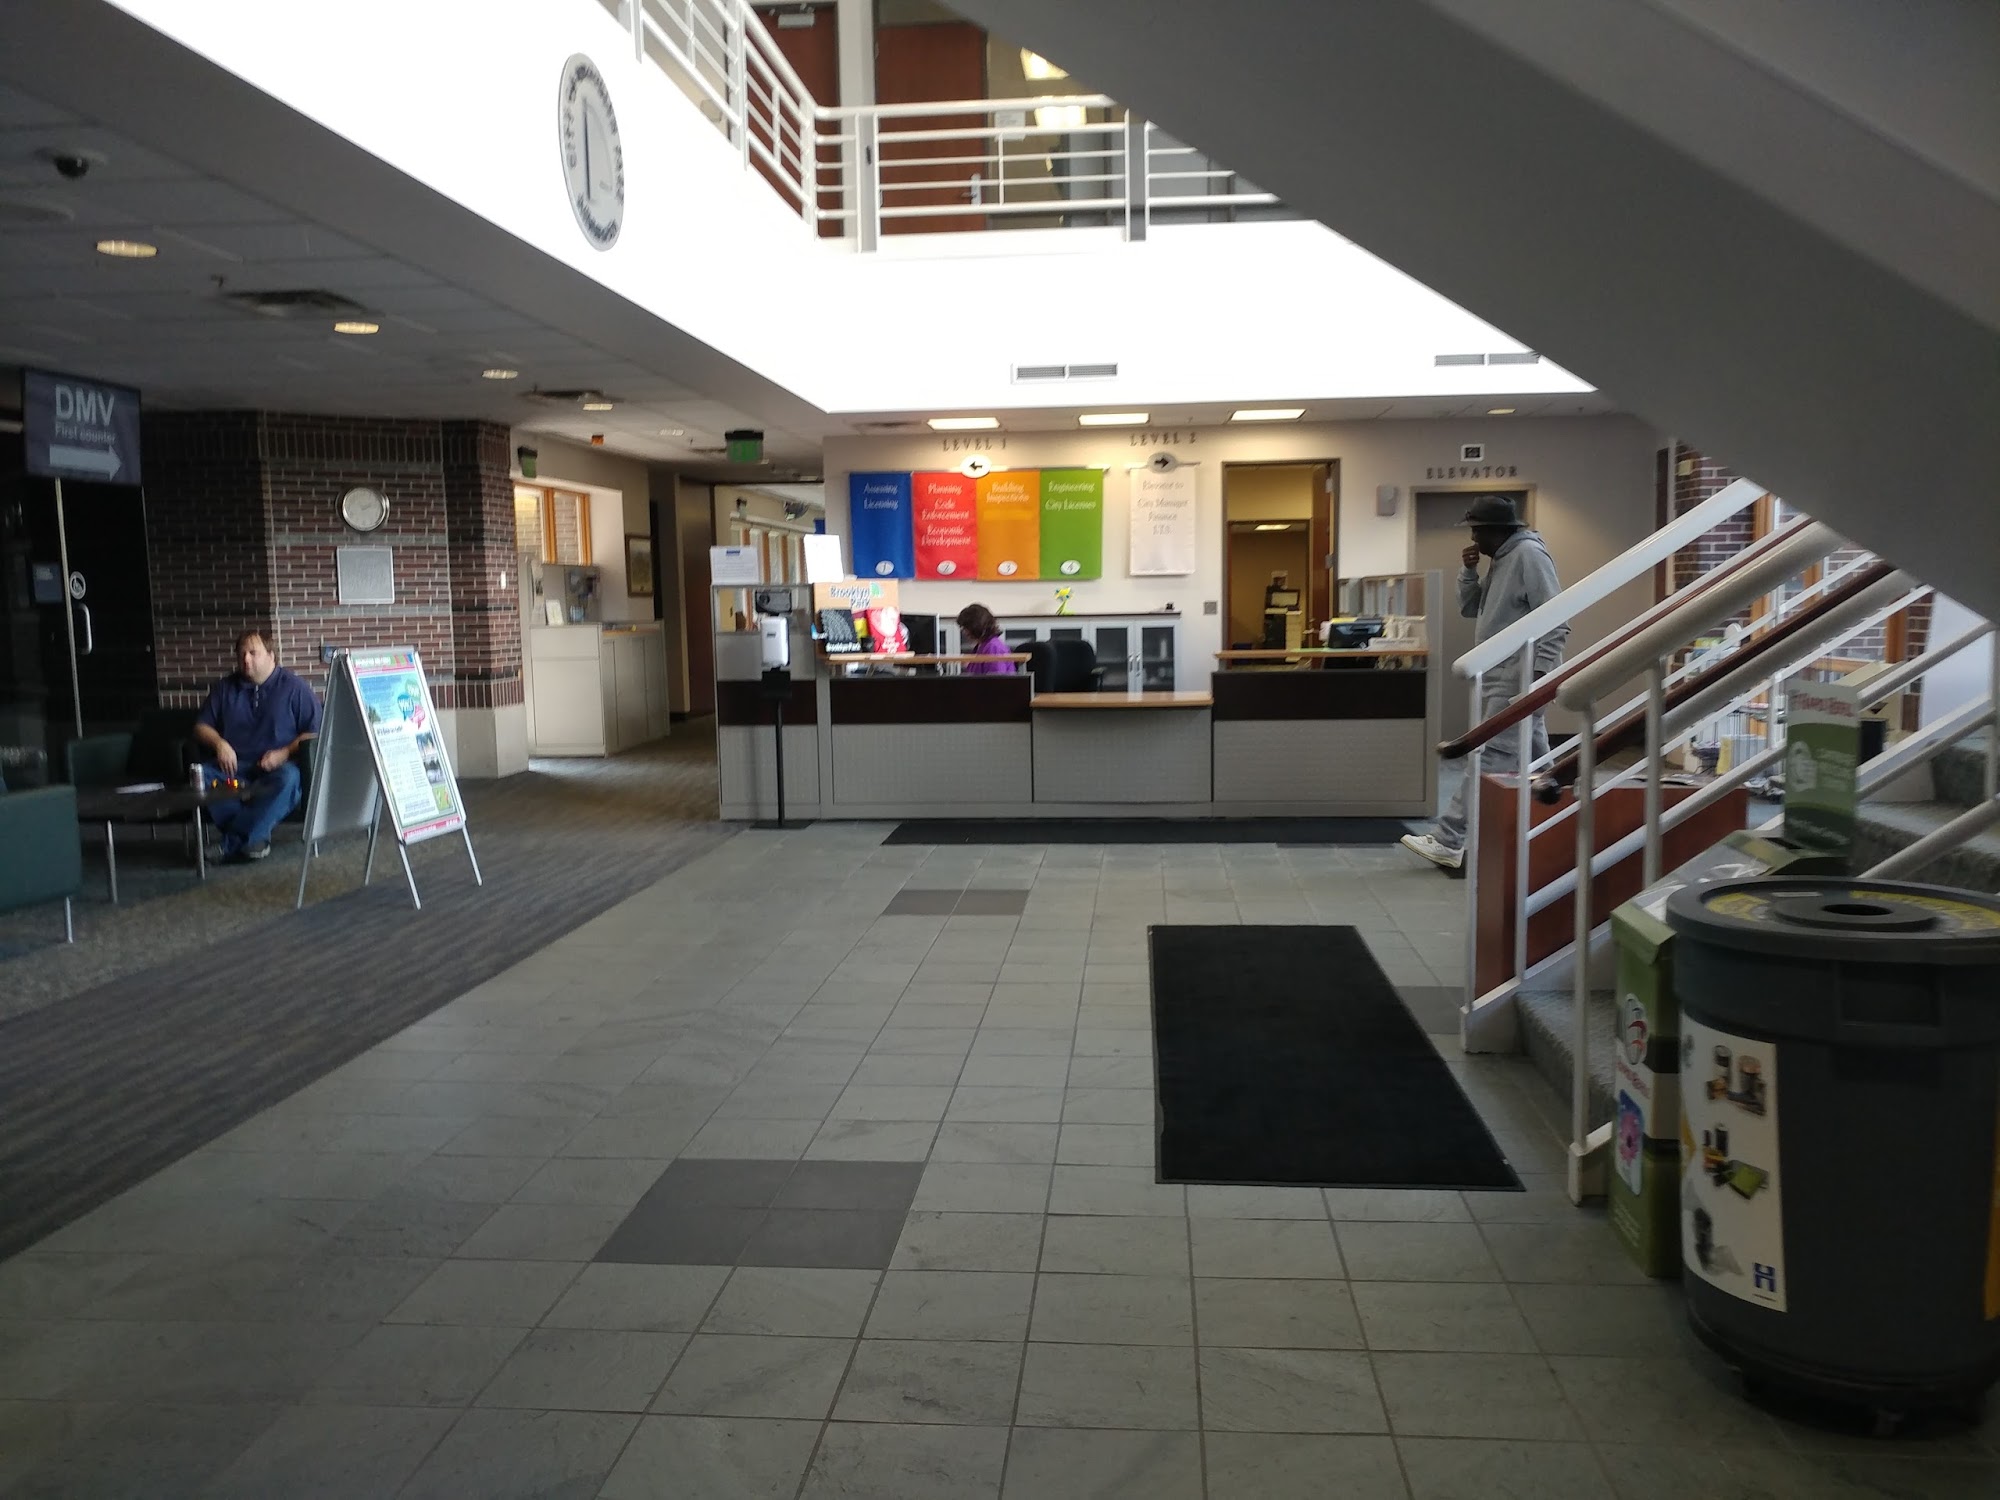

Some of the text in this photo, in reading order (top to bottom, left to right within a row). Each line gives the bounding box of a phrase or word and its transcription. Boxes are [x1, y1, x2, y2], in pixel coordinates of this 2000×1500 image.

[55, 384, 115, 426] DMV
[943, 437, 992, 452] LEVEL
[1129, 431, 1197, 446] LEVEL 2
[1426, 465, 1518, 480] ELEVATOR
[831, 586, 870, 600] Brooklyn
[851, 598, 870, 610] Park
